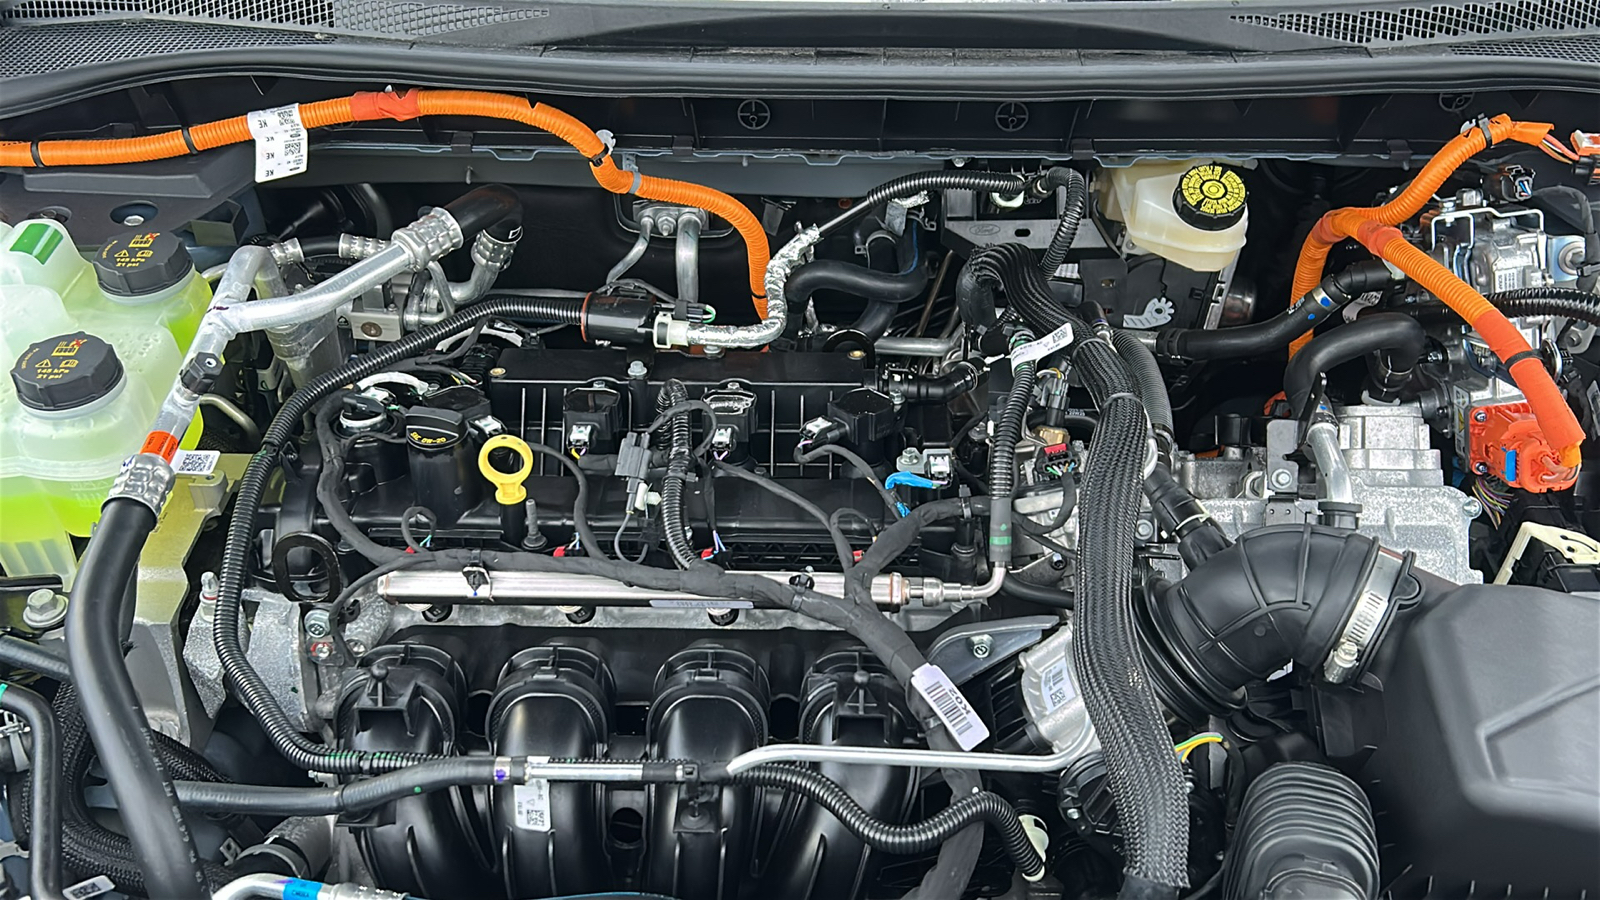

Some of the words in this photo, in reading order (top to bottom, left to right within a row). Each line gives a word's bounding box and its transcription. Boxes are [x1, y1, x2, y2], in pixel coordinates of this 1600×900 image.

[258, 119, 268, 128] KE
[266, 152, 275, 160] KE
[265, 169, 275, 177] KE
[949, 687, 971, 715] K02
